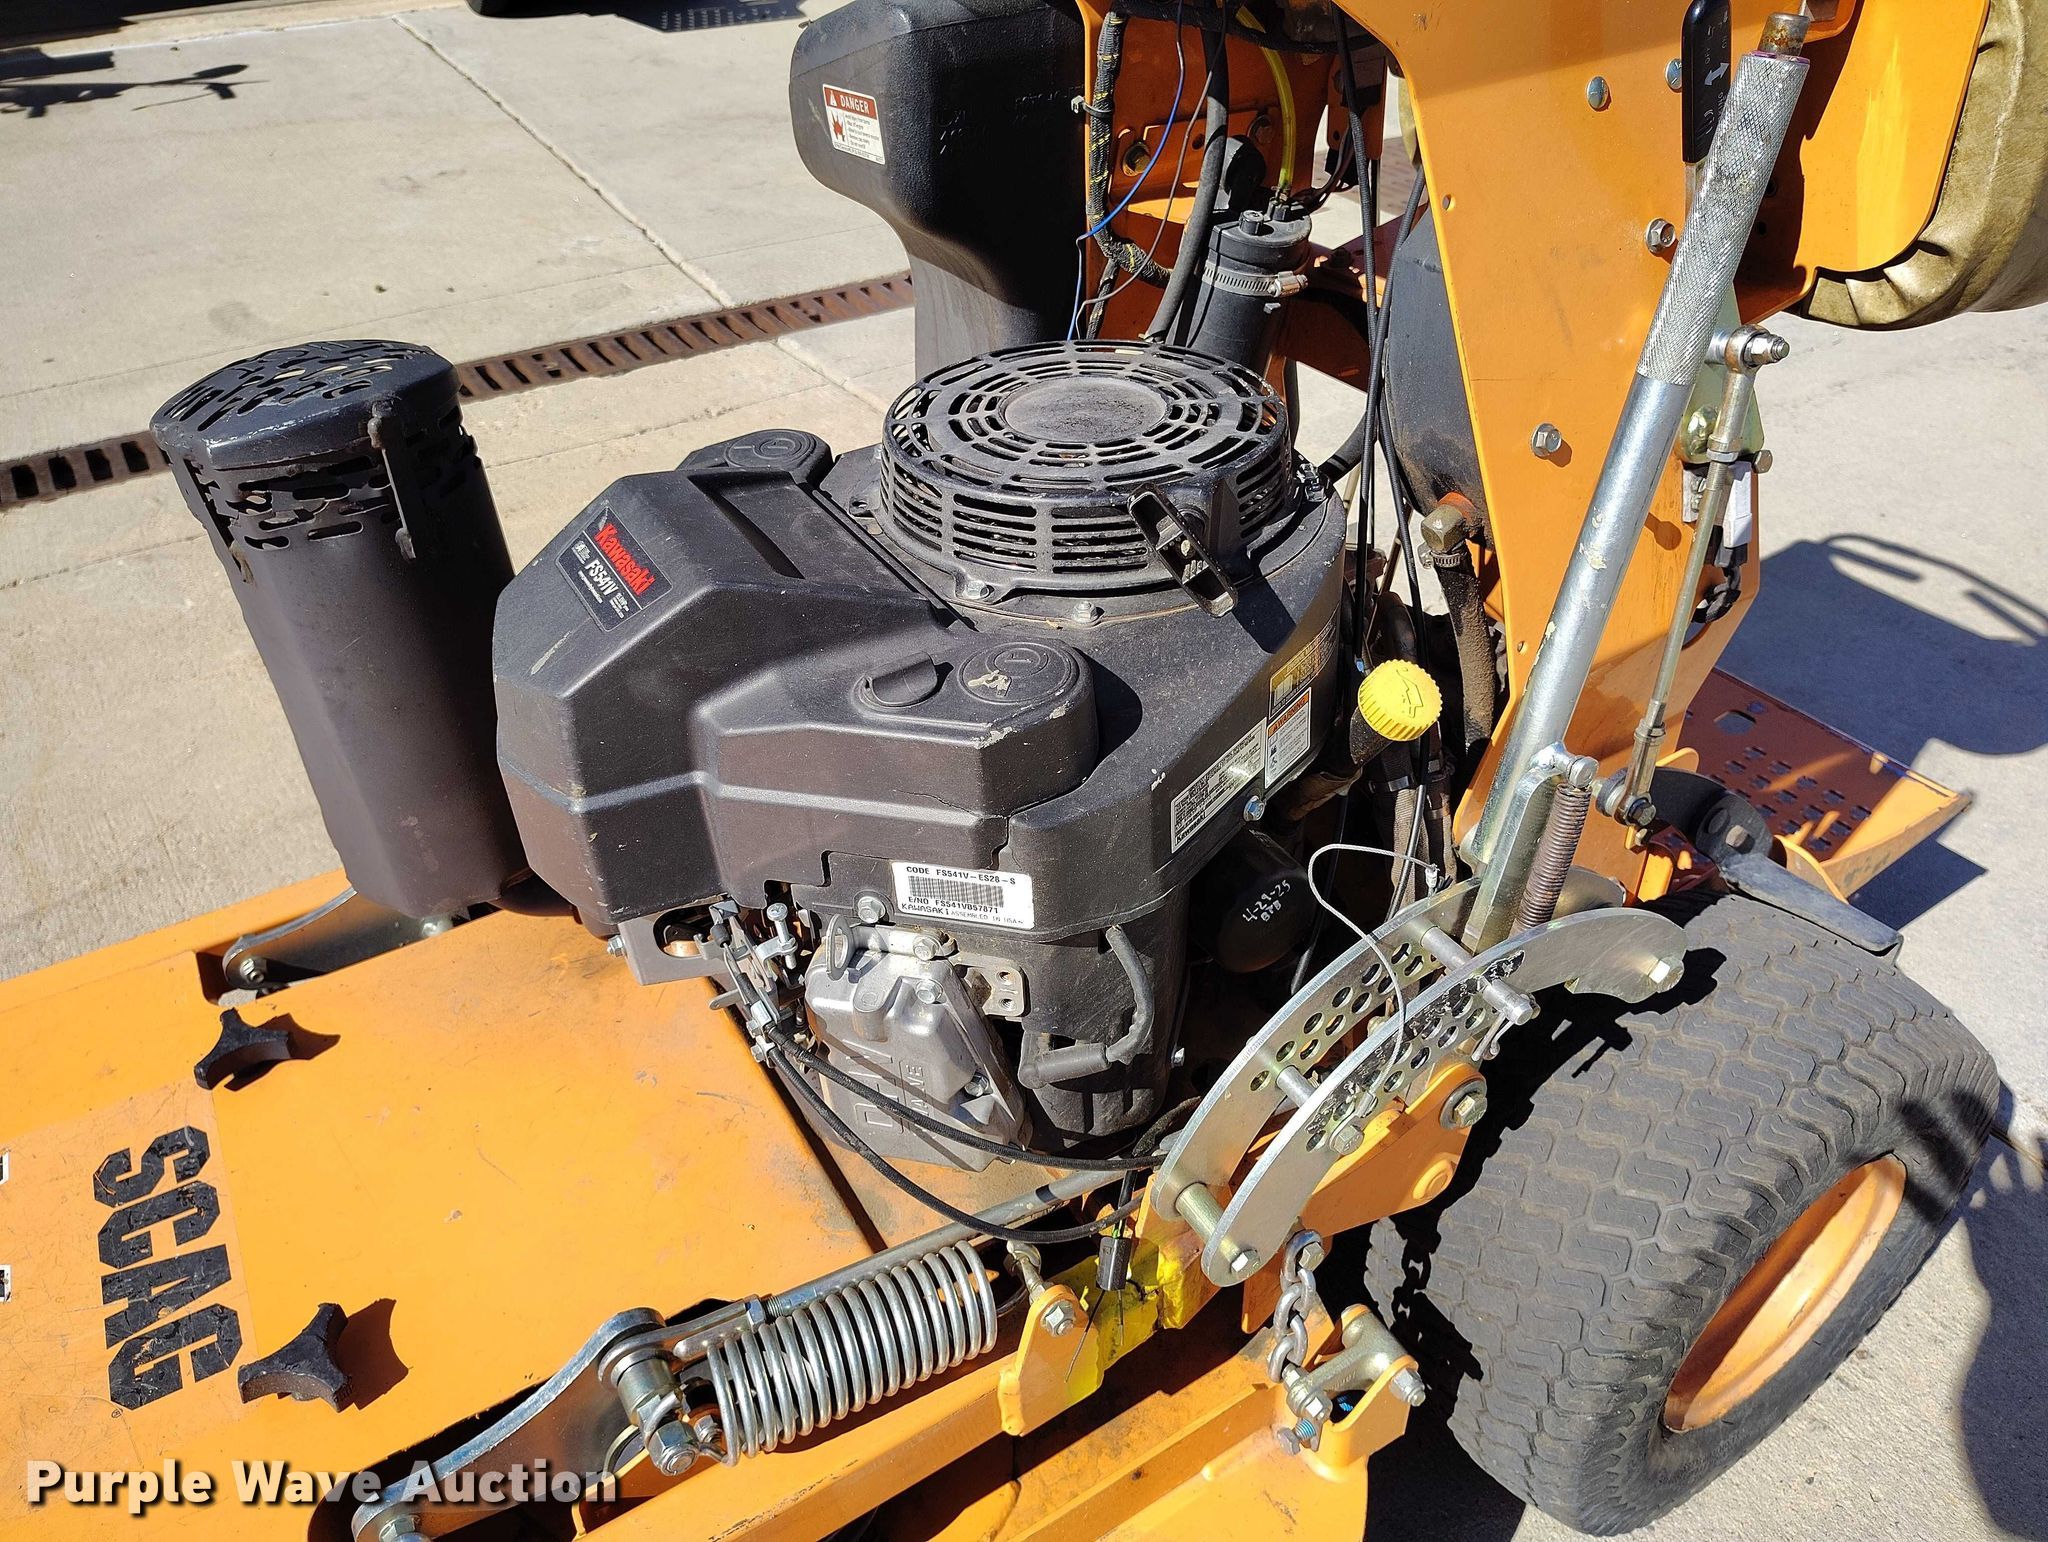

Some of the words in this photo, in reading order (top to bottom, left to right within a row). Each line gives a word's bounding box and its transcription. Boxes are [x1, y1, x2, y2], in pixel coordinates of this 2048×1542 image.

[840, 94, 870, 115] DANGER
[594, 523, 656, 597] Kawasaki
[584, 559, 619, 596] FS541V
[906, 866, 930, 875] CODE
[901, 903, 949, 915] KAWASAKI
[908, 897, 929, 905] E/NO
[93, 1125, 243, 1410] SCAG
